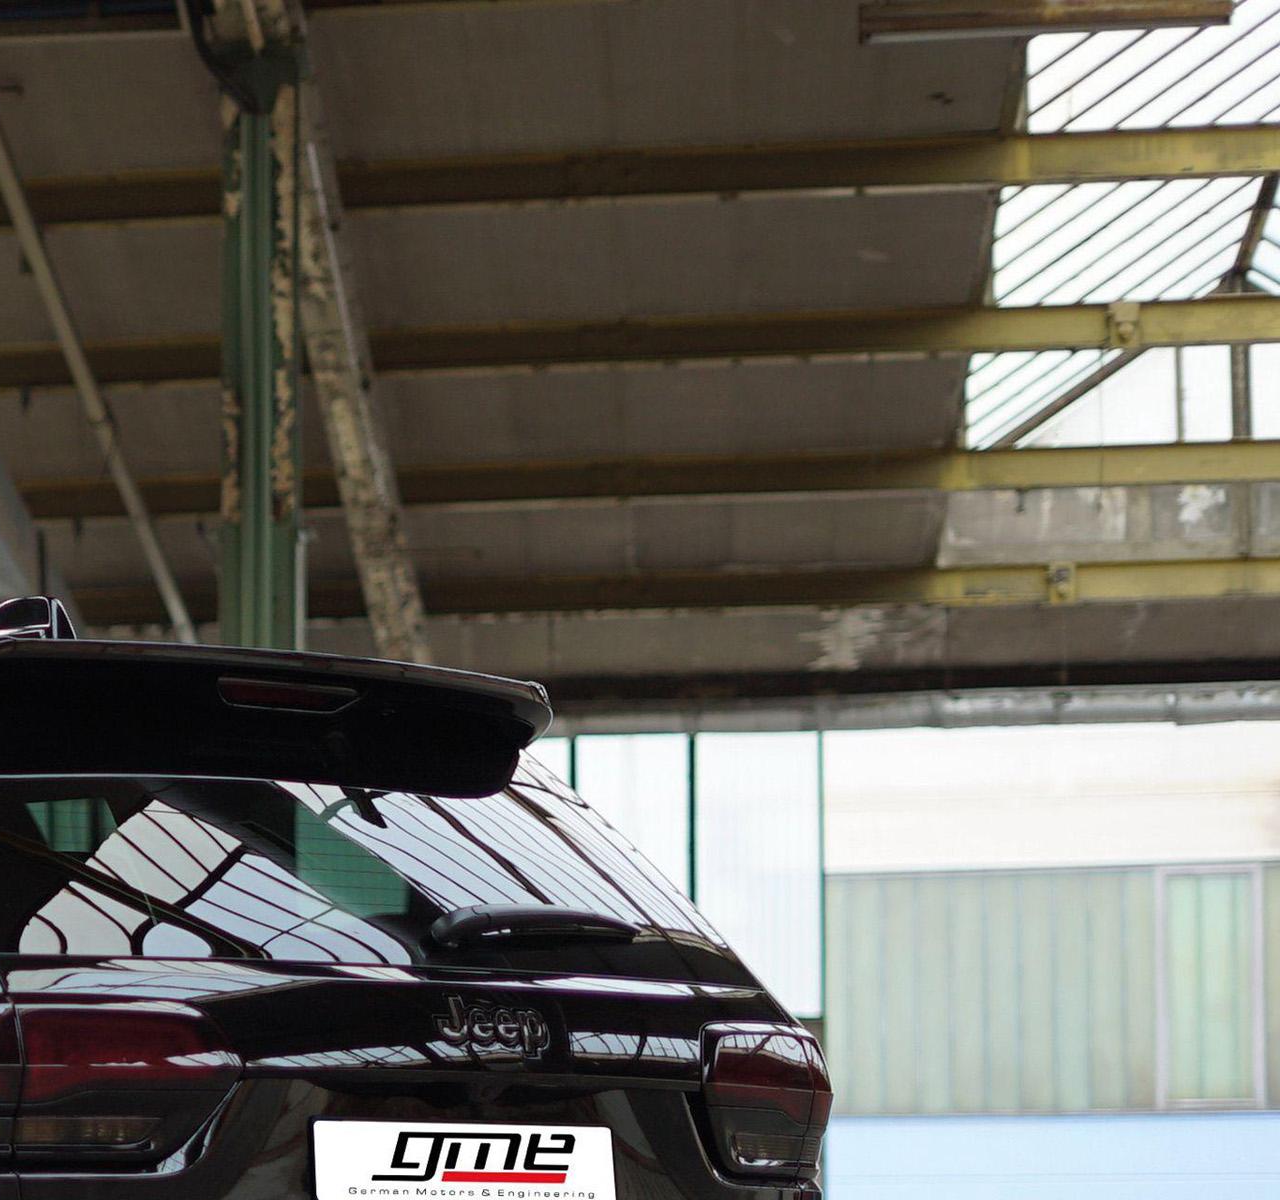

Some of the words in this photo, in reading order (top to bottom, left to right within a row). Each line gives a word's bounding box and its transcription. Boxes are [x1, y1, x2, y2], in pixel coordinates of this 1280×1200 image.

[433, 994, 550, 1060] Jeep
[348, 1187, 410, 1196] German
[416, 1188, 476, 1197] Motors
[481, 1189, 491, 1198] &
[497, 1189, 596, 1200] Engineering
